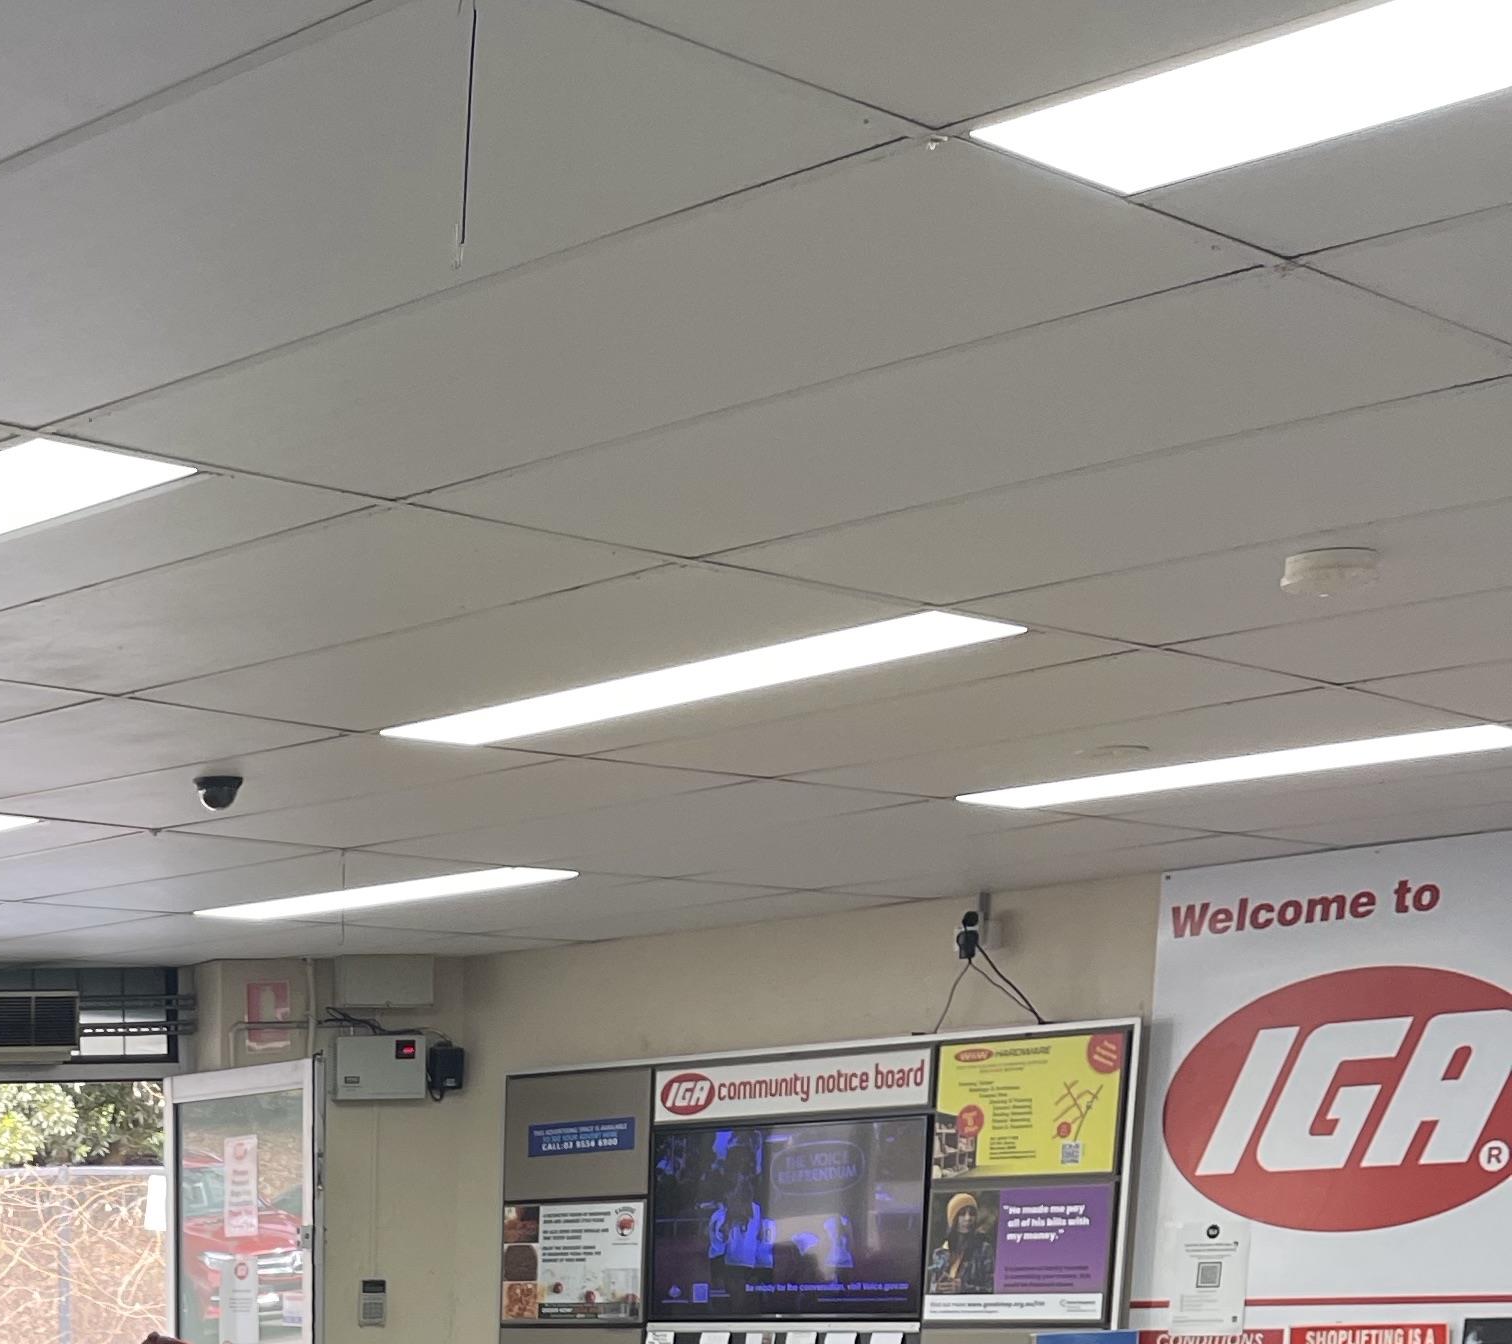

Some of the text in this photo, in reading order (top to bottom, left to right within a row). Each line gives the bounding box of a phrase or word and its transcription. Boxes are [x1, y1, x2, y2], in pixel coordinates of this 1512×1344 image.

[1171, 880, 1440, 938] Welcome to
[666, 1059, 925, 1107] IGA community notice board
[811, 1152, 849, 1165] VOICE
